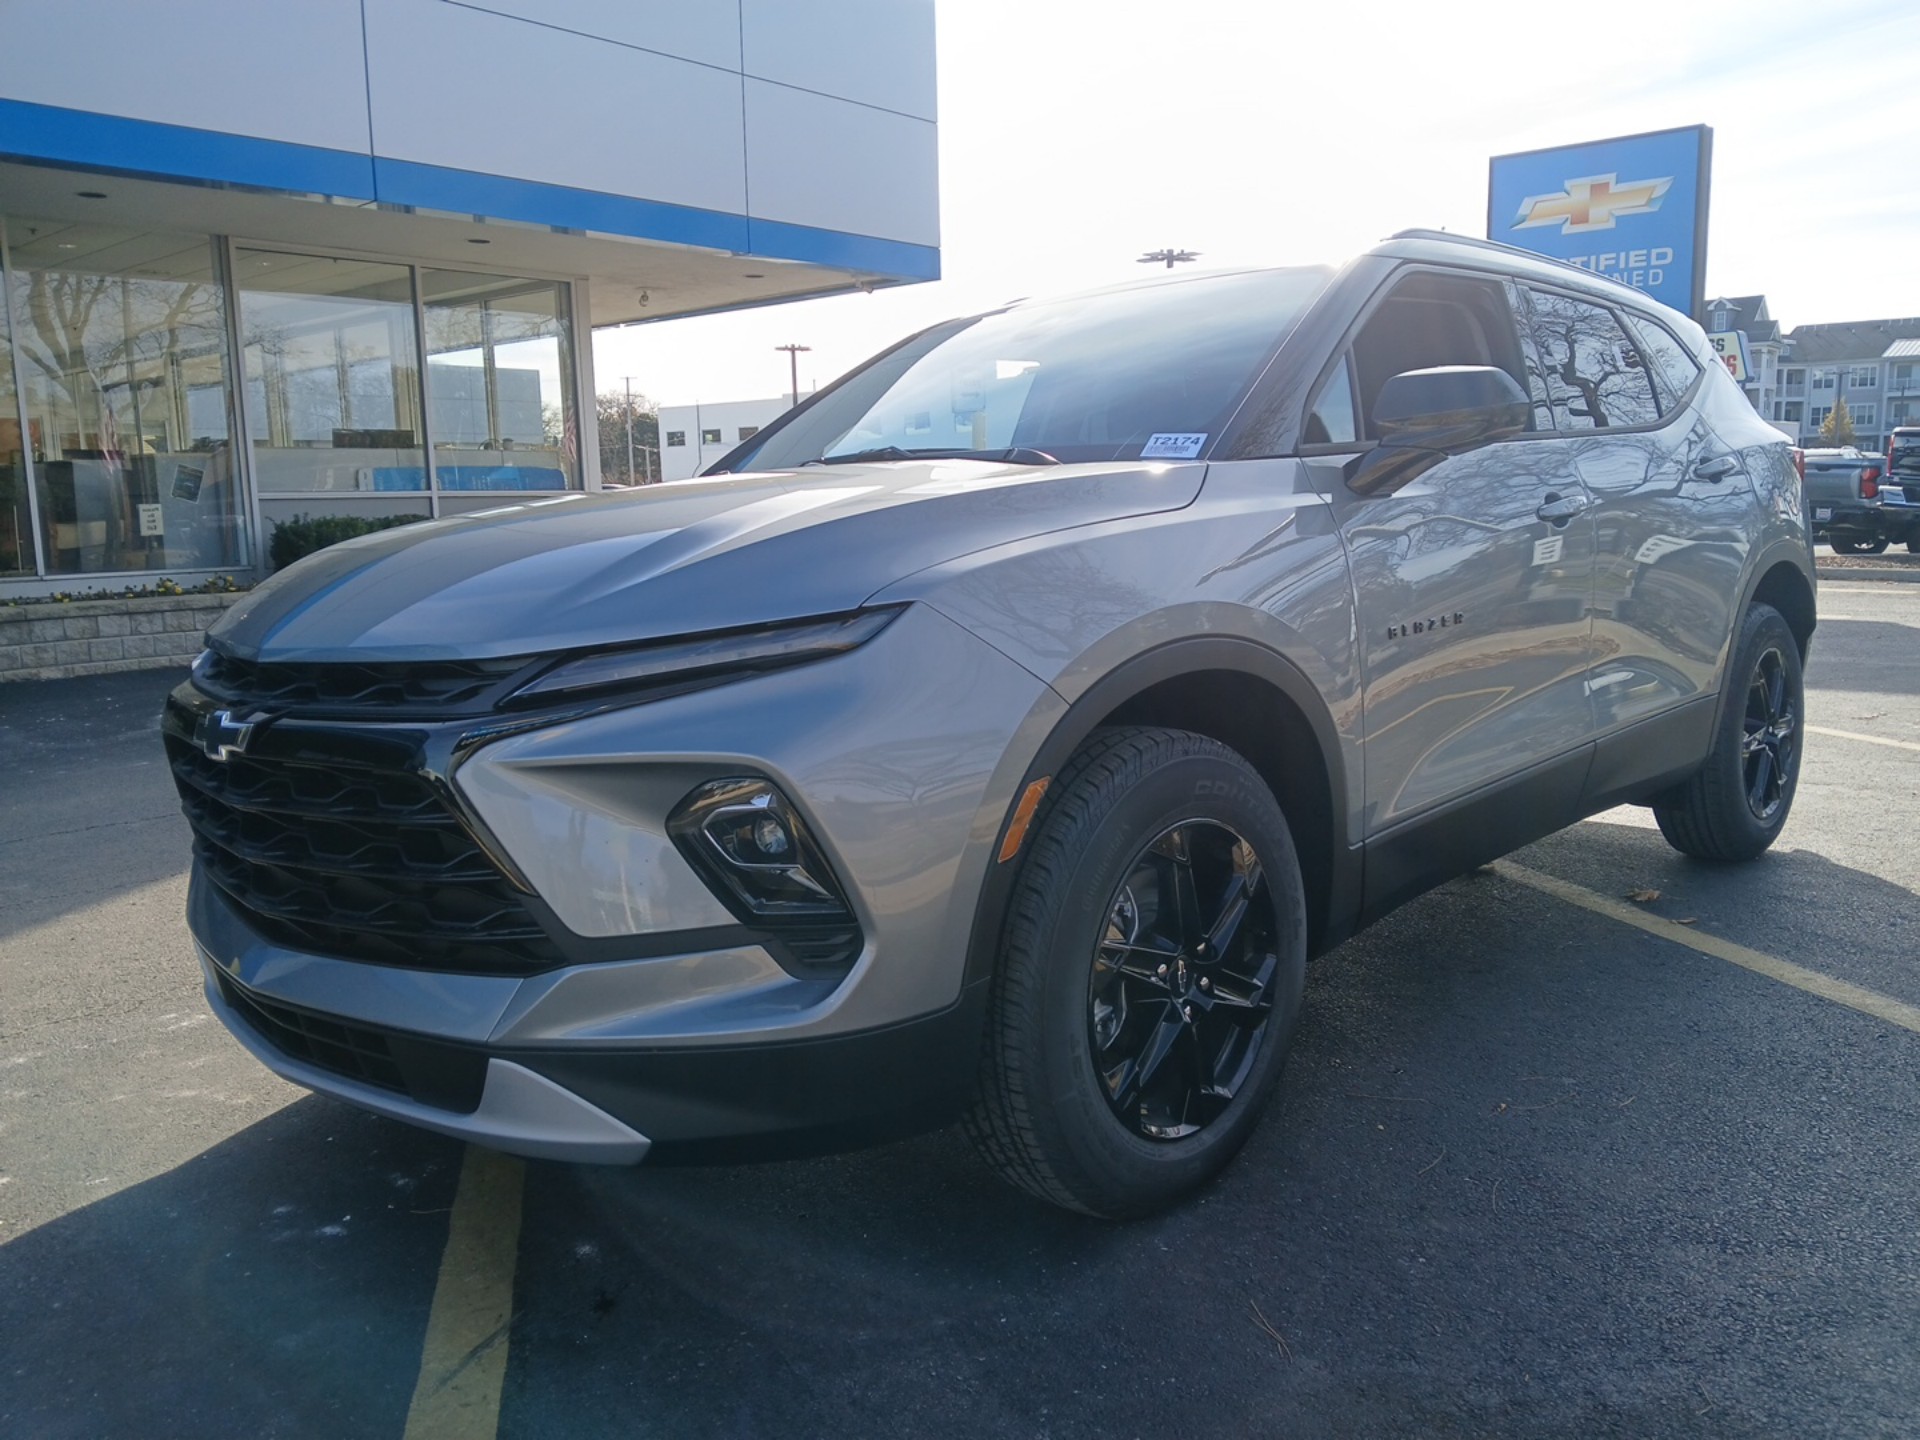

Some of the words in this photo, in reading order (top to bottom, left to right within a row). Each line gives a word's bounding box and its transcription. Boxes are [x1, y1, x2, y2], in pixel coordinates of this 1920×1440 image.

[1561, 247, 1673, 271] TIFIED
[1606, 269, 1663, 286] NED
[1153, 436, 1201, 445] T2174
[1387, 611, 1464, 640] BLAZER
